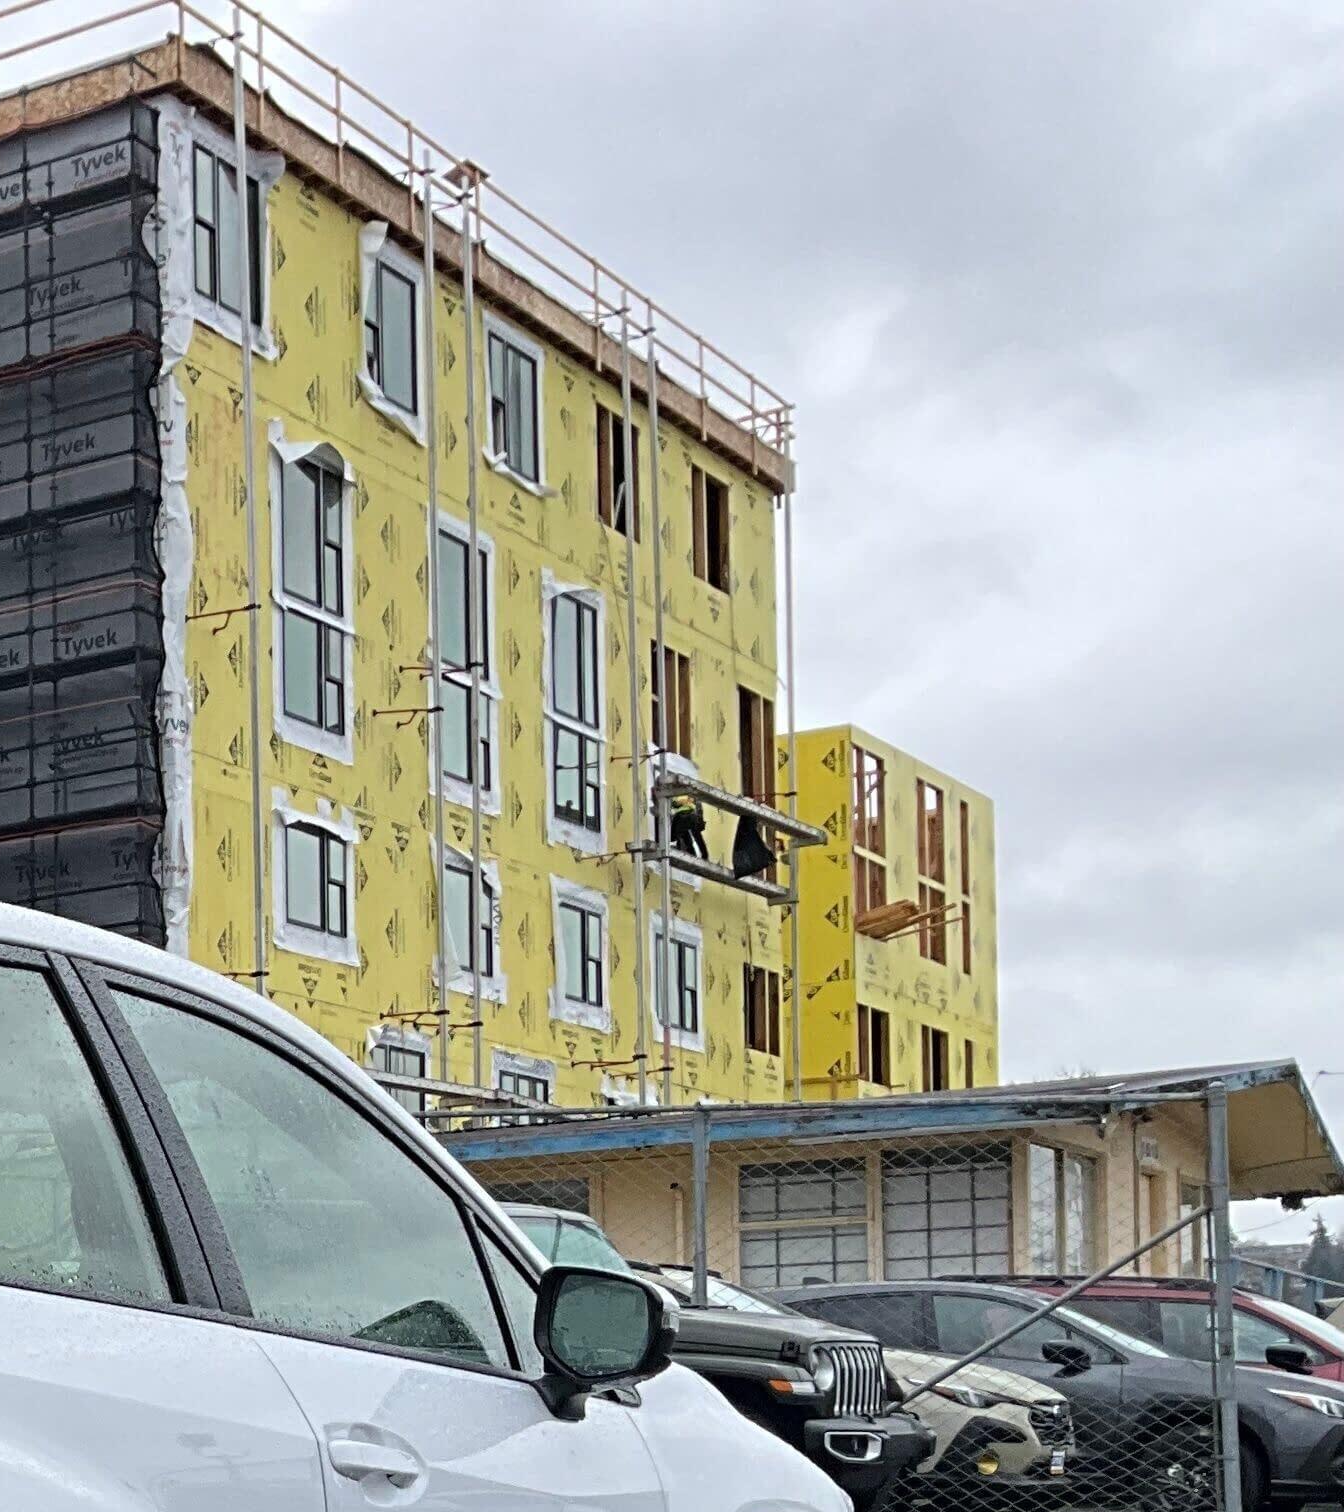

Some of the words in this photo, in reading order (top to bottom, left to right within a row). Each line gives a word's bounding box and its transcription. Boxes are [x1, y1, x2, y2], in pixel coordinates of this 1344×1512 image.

[71, 145, 126, 178] Tyvek
[42, 433, 95, 462] Tyvek
[62, 628, 117, 657] Tyvek
